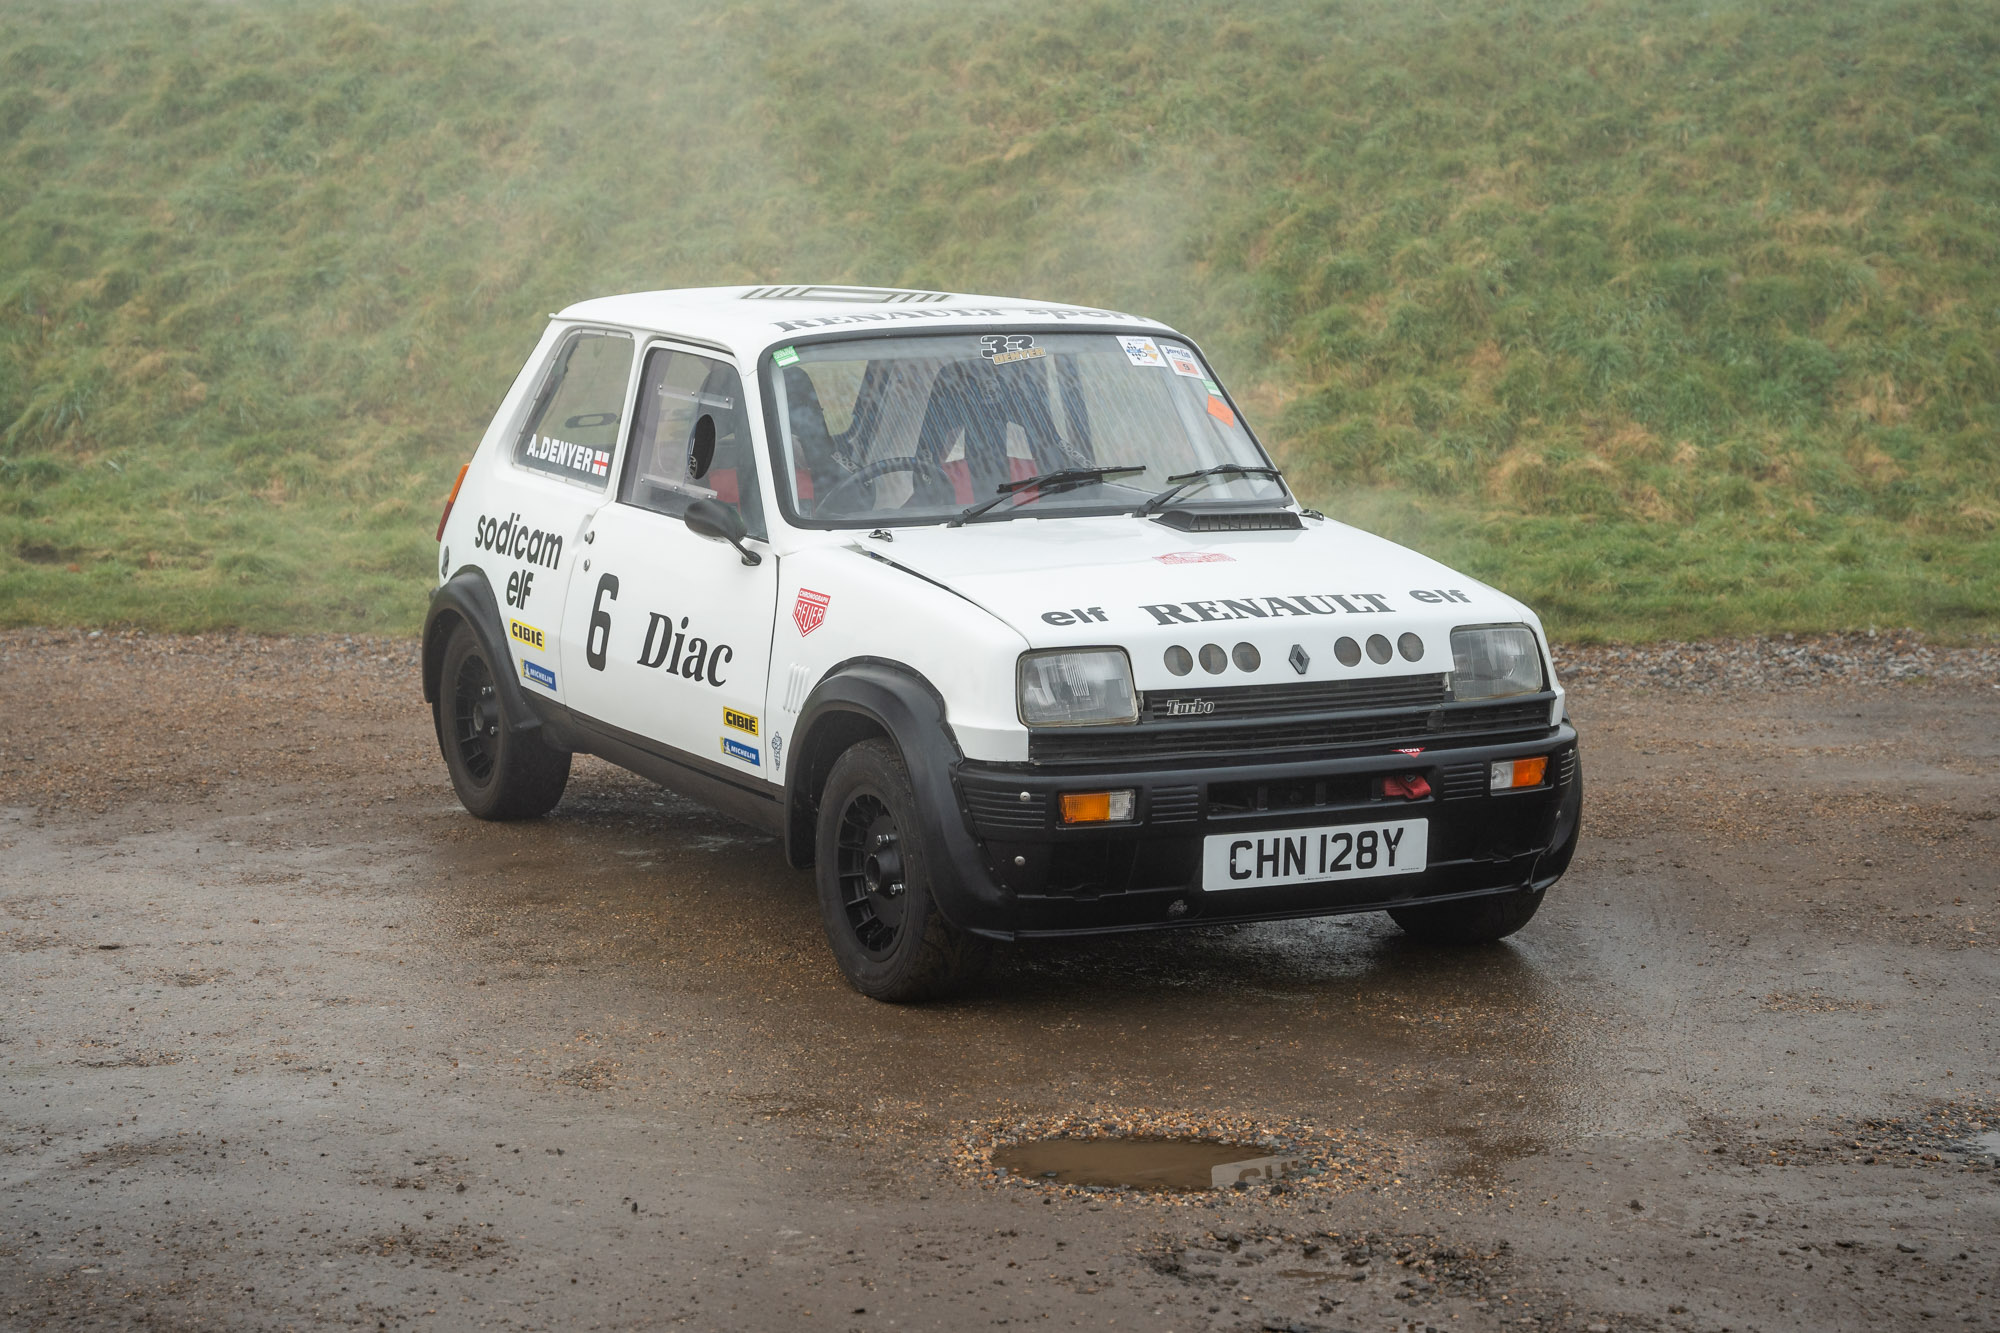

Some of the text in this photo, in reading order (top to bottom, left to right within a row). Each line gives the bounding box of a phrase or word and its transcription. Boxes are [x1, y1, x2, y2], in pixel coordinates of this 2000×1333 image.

[772, 309, 1007, 332] RENAULT
[992, 346, 1046, 365] DENYER
[526, 433, 594, 472] A.DENYER
[474, 512, 563, 570] sodicam
[506, 569, 535, 610] elf
[1408, 589, 1472, 604] elf
[586, 572, 620, 672] 6
[795, 602, 824, 631] HEUER
[1040, 606, 1110, 626] elf
[1138, 593, 1397, 626] RENAULT
[637, 611, 733, 688] Diac
[529, 668, 553, 684] MICHELIN
[1166, 698, 1215, 716] Turbo
[730, 745, 756, 761] MICHELIN
[1229, 827, 1405, 881] CHN 128Y
